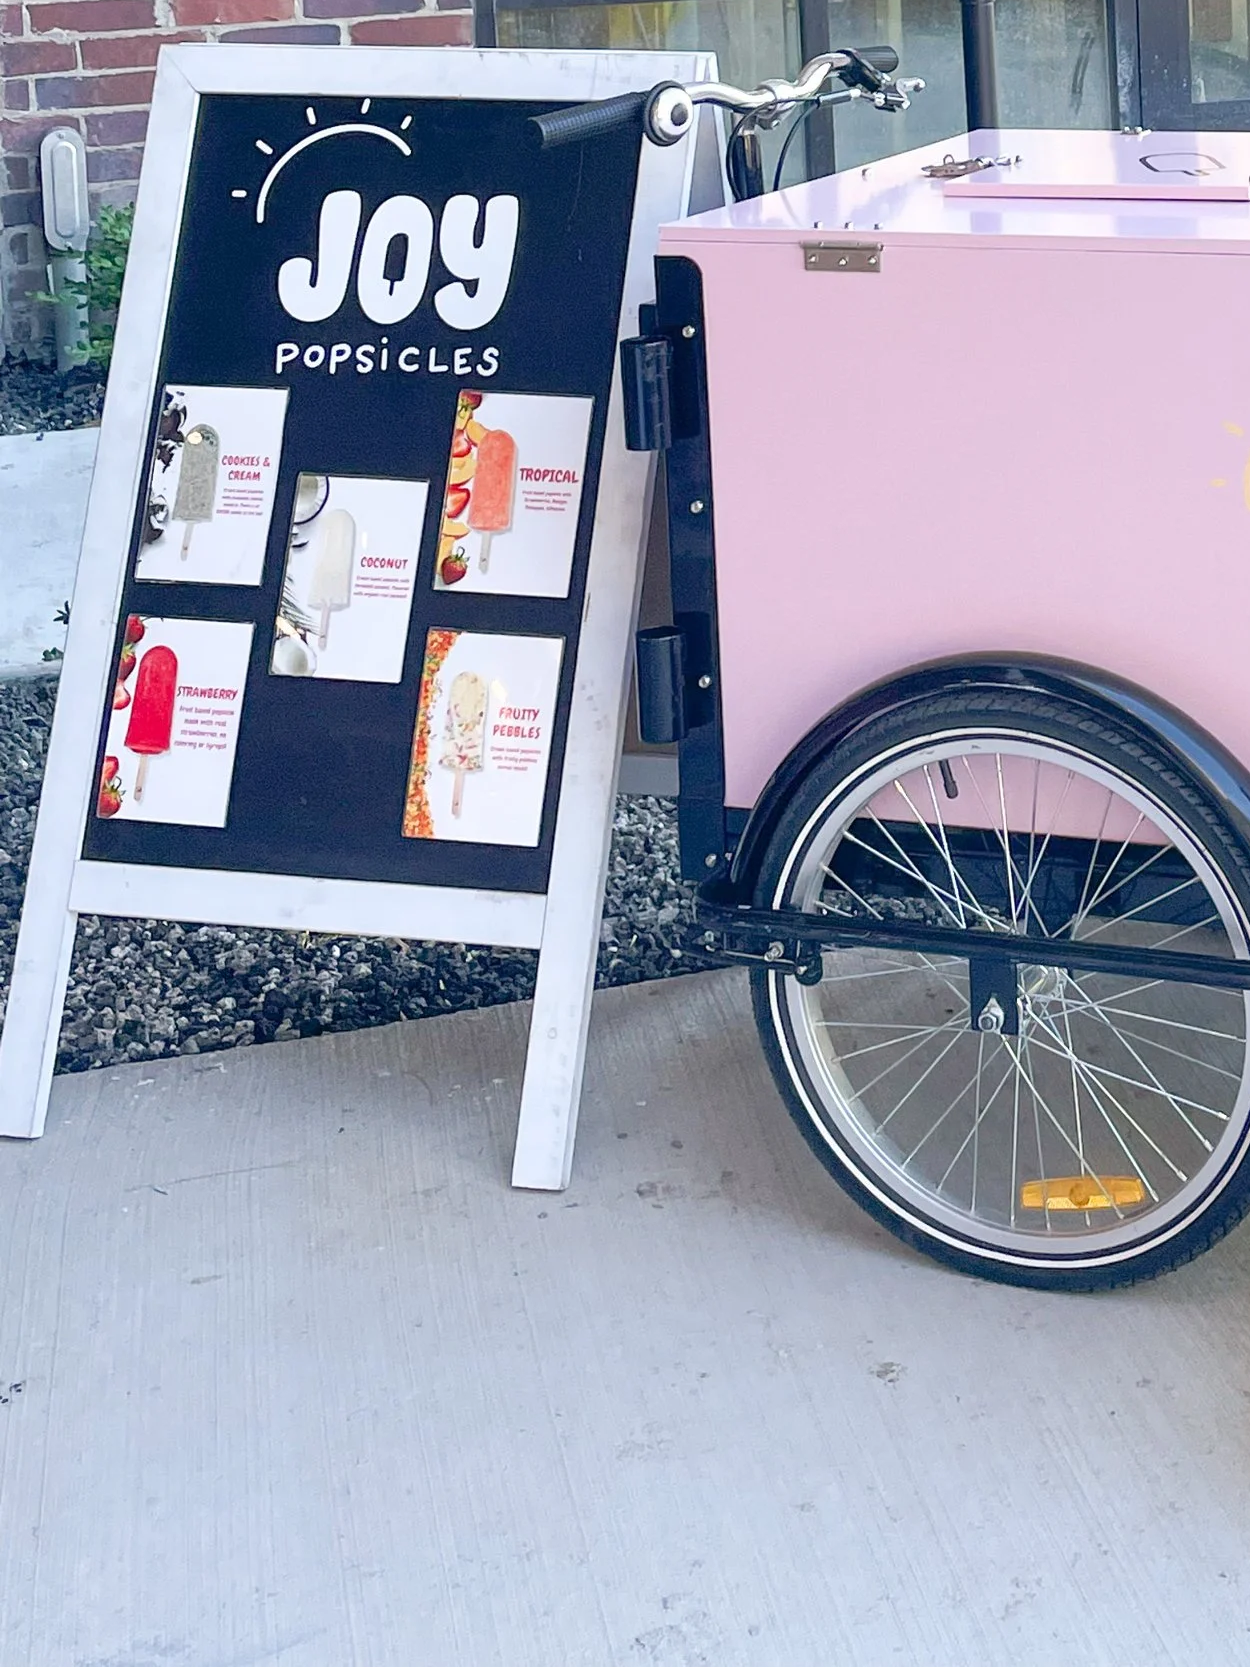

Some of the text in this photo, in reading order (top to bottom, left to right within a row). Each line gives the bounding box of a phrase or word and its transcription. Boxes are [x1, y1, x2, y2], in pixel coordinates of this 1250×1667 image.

[278, 189, 519, 331] JOY
[221, 454, 271, 467] COOKIES &
[228, 469, 261, 481] CREAM
[519, 467, 579, 484] TROPICAL
[360, 555, 409, 570] COCONUT
[176, 685, 239, 701] STRAWBERRY
[498, 706, 541, 722] FRUITY
[492, 723, 542, 740] PEBBLES
